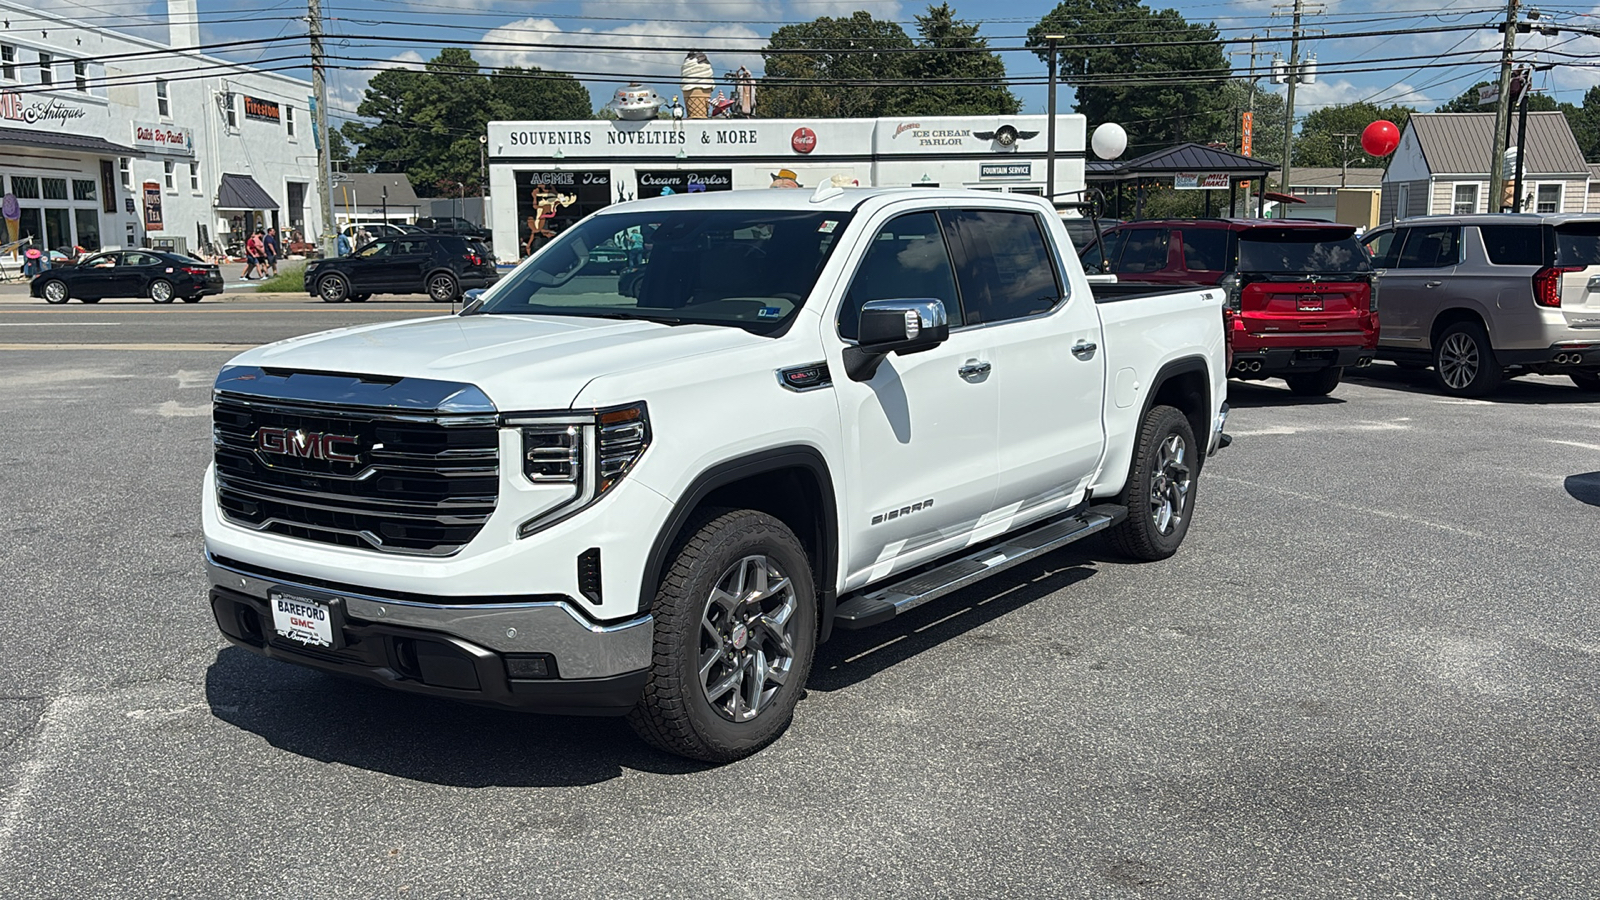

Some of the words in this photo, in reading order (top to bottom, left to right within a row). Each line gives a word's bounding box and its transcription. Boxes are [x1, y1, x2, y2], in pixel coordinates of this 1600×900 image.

[244, 97, 279, 118] Firestone
[137, 127, 153, 140] Dutch
[155, 129, 166, 145] Boy
[167, 130, 184, 144] Paints
[510, 131, 592, 145] SOUVENIRS
[607, 130, 686, 145] NOVELTIES
[701, 131, 711, 144] &
[716, 130, 757, 144] MORE
[912, 130, 930, 138] ICE
[932, 130, 970, 138] CREAM
[919, 138, 962, 146] PARLOR
[982, 166, 1007, 175] FOUNTAIN
[1008, 166, 1029, 174] SERVICE
[530, 173, 574, 185] ACME
[582, 173, 608, 185] Ice
[640, 173, 682, 185] Cream
[687, 173, 729, 185] Parlor
[148, 209, 160, 221] TEA
[258, 426, 362, 464] GMC
[870, 498, 934, 526] SIERRA
[277, 600, 326, 621] BAREFORD
[290, 616, 316, 630] GMC
